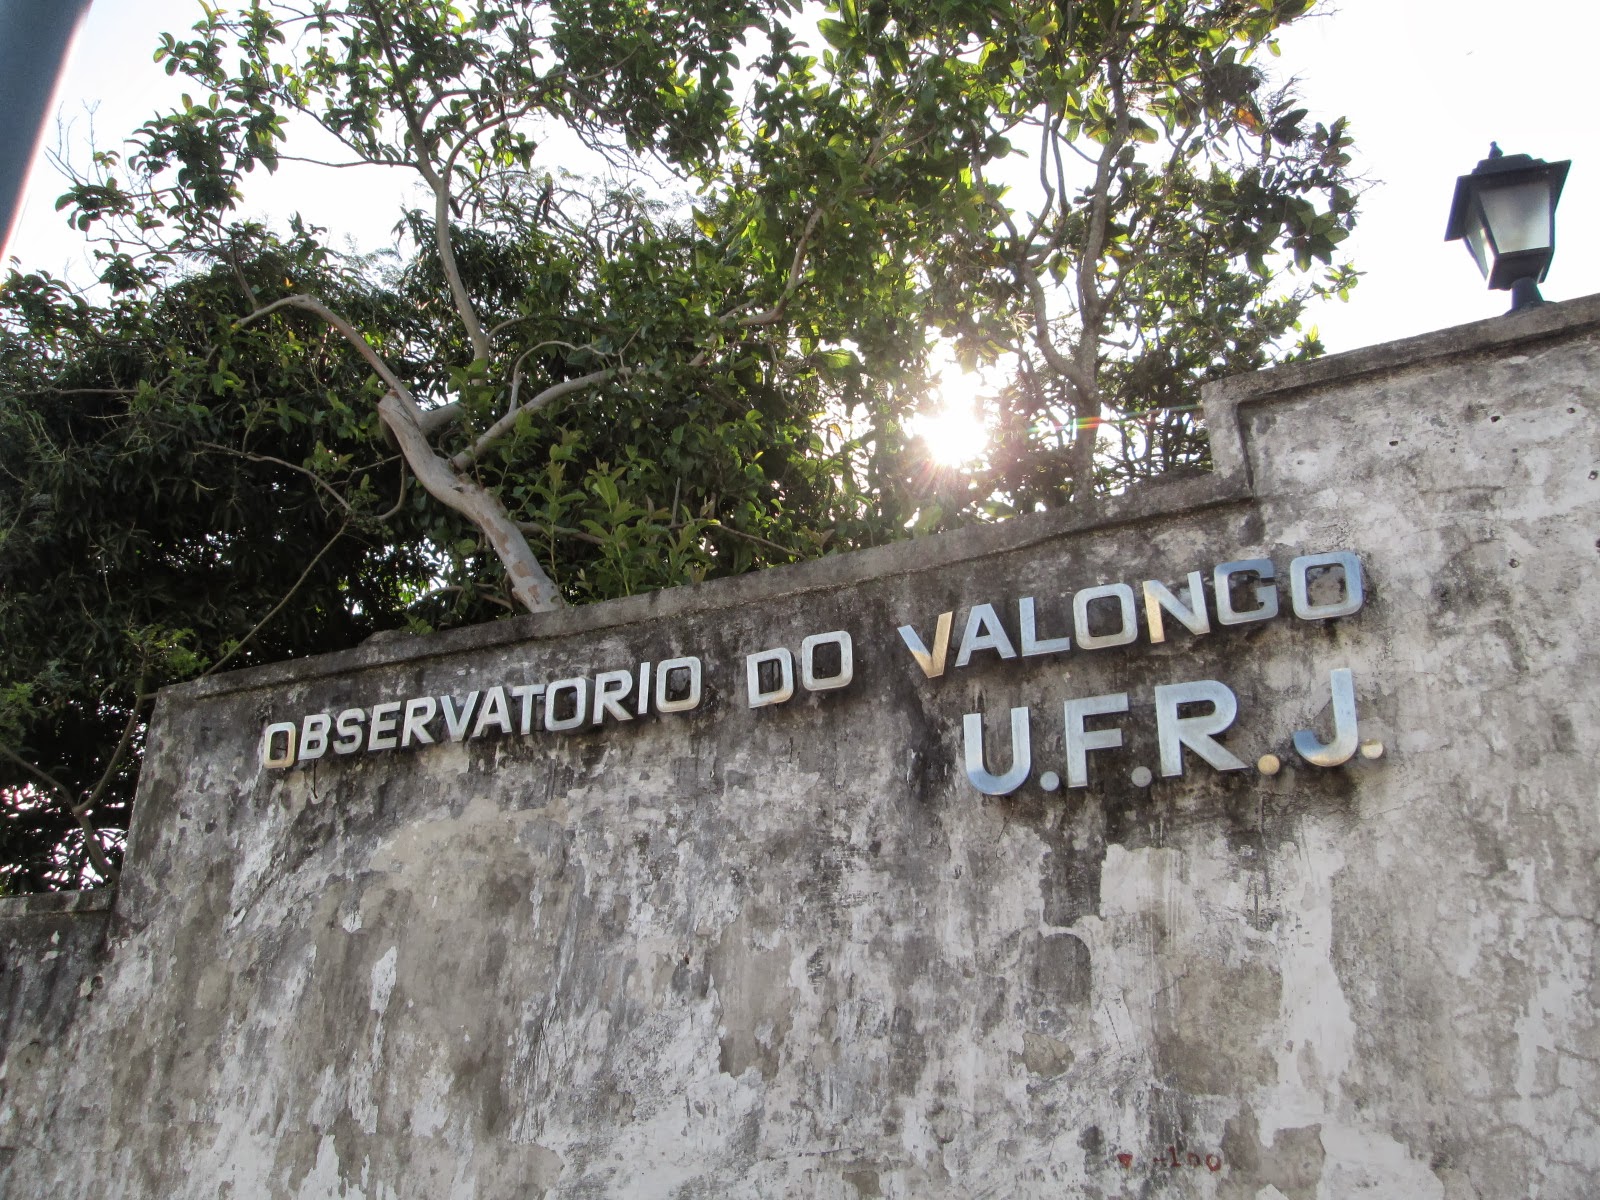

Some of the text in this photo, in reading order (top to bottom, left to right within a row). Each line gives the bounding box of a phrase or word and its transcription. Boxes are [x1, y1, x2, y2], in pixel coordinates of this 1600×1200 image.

[264, 551, 1363, 769] OBSERVATORIO DO VALONGO
